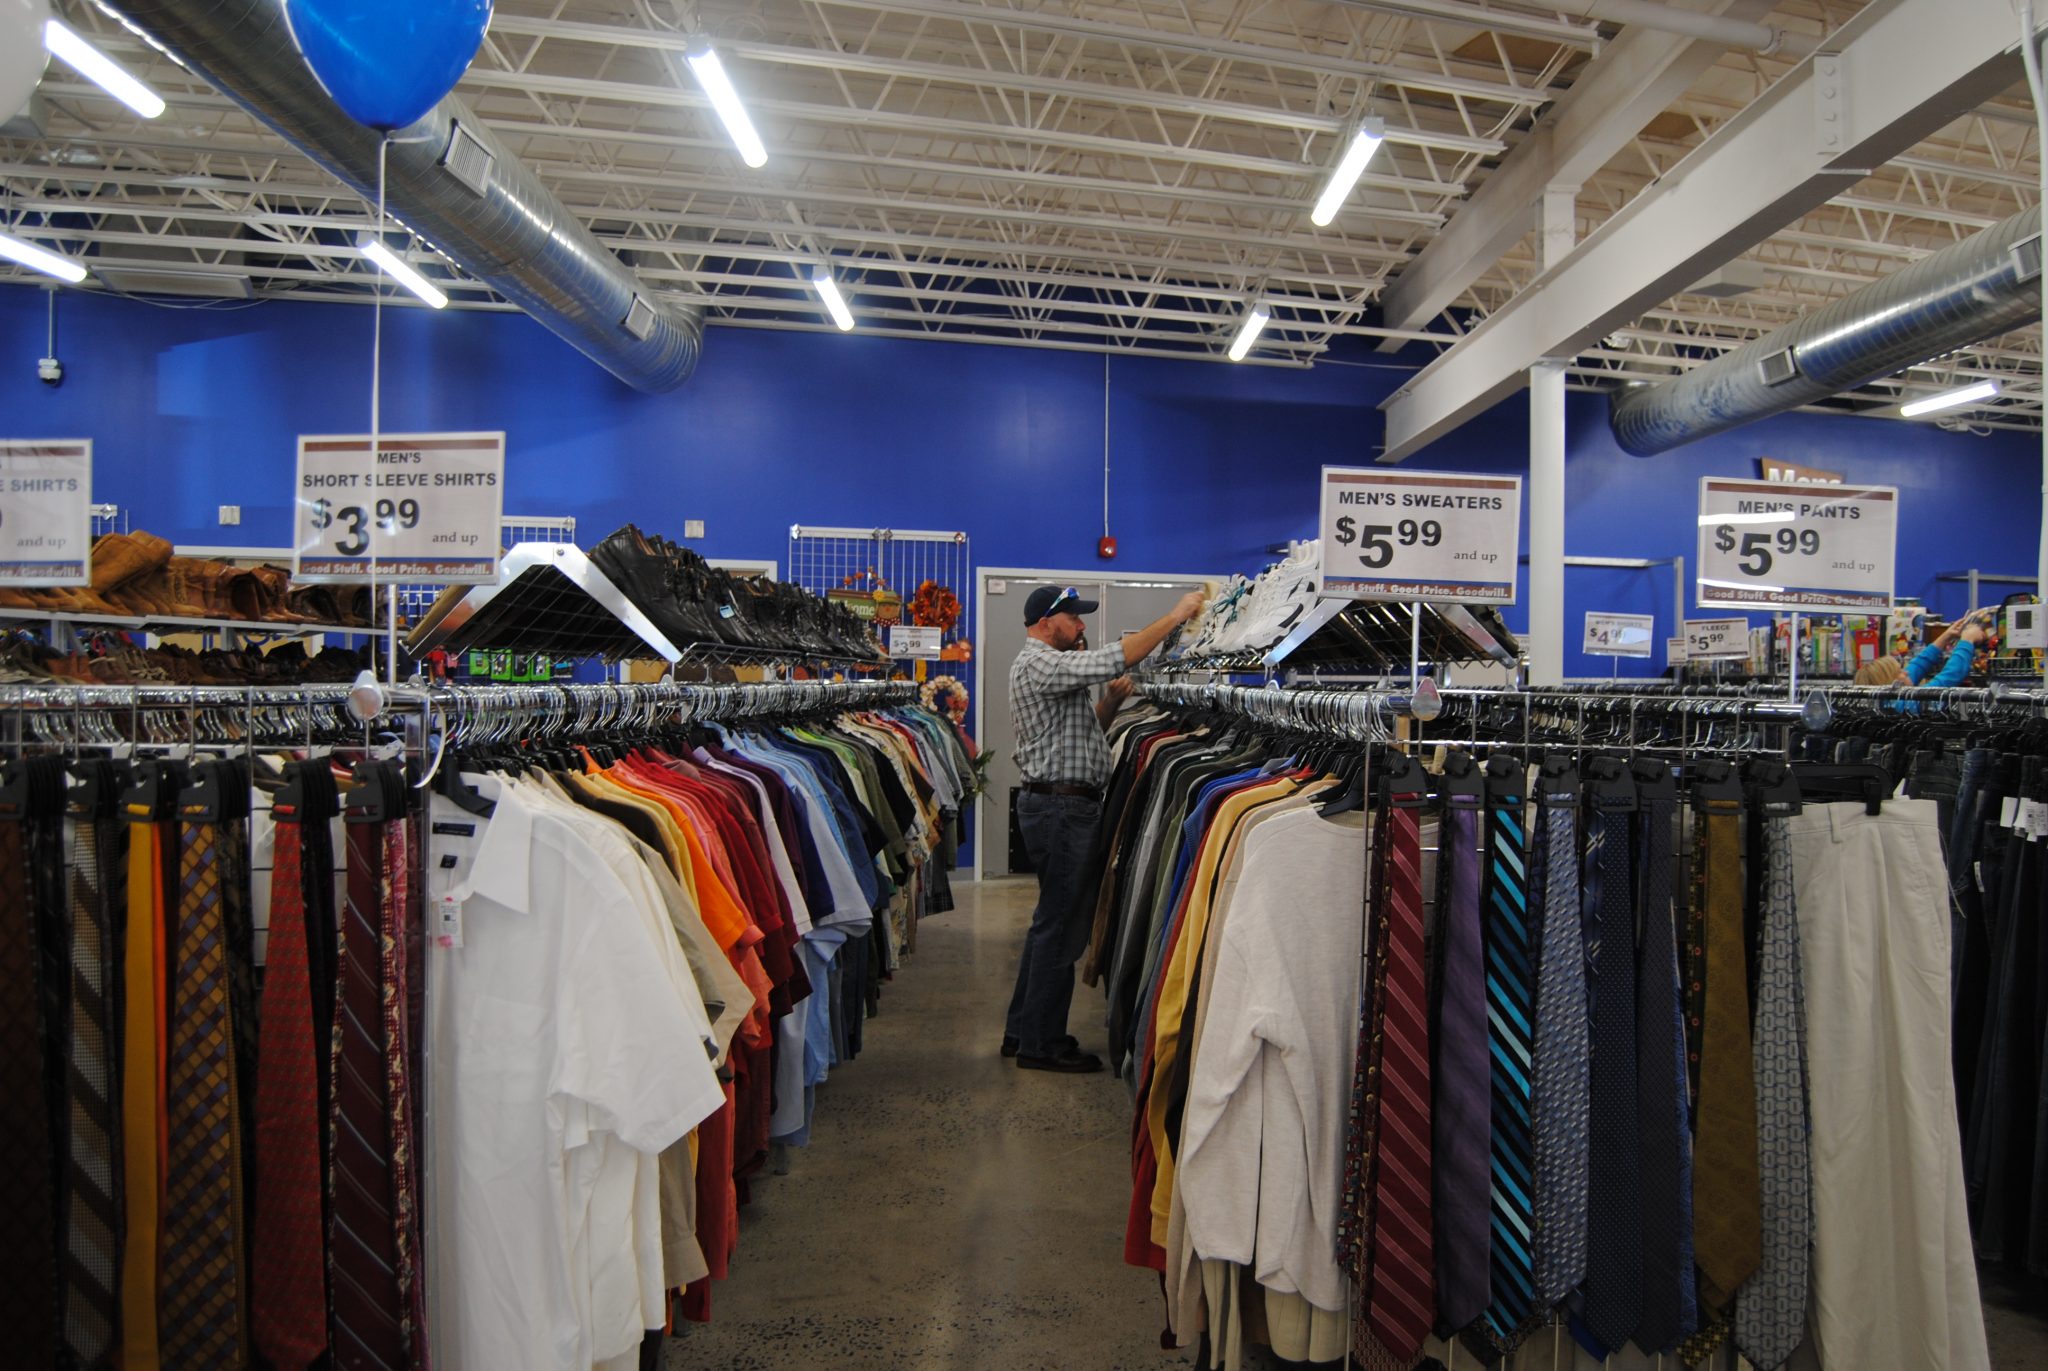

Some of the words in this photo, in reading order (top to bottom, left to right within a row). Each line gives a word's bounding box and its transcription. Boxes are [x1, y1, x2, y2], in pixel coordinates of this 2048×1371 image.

[377, 452, 421, 464] MEN'S
[10, 478, 78, 492] SHIRTS
[303, 474, 359, 487] SHORT
[365, 473, 428, 487] SLEEVE
[434, 472, 497, 486] SHIRTS
[1339, 491, 1396, 506] MEN'S
[1402, 494, 1502, 510] SWEATERS
[1738, 500, 1794, 514] MEN'S
[1800, 503, 1860, 519] PANTS
[17, 536, 43, 547] and
[48, 538, 66, 549] up
[432, 532, 457, 543] and
[462, 535, 479, 546] up
[1454, 550, 1477, 560] and
[1482, 553, 1497, 563] up
[400, 564, 431, 575] Price.
[435, 564, 490, 575] Goodwill.
[1832, 560, 1855, 570] and
[1859, 562, 1875, 573] up
[1390, 584, 1420, 594] Good
[1456, 587, 1508, 597] Goodwill.
[1769, 592, 1798, 602] Good
